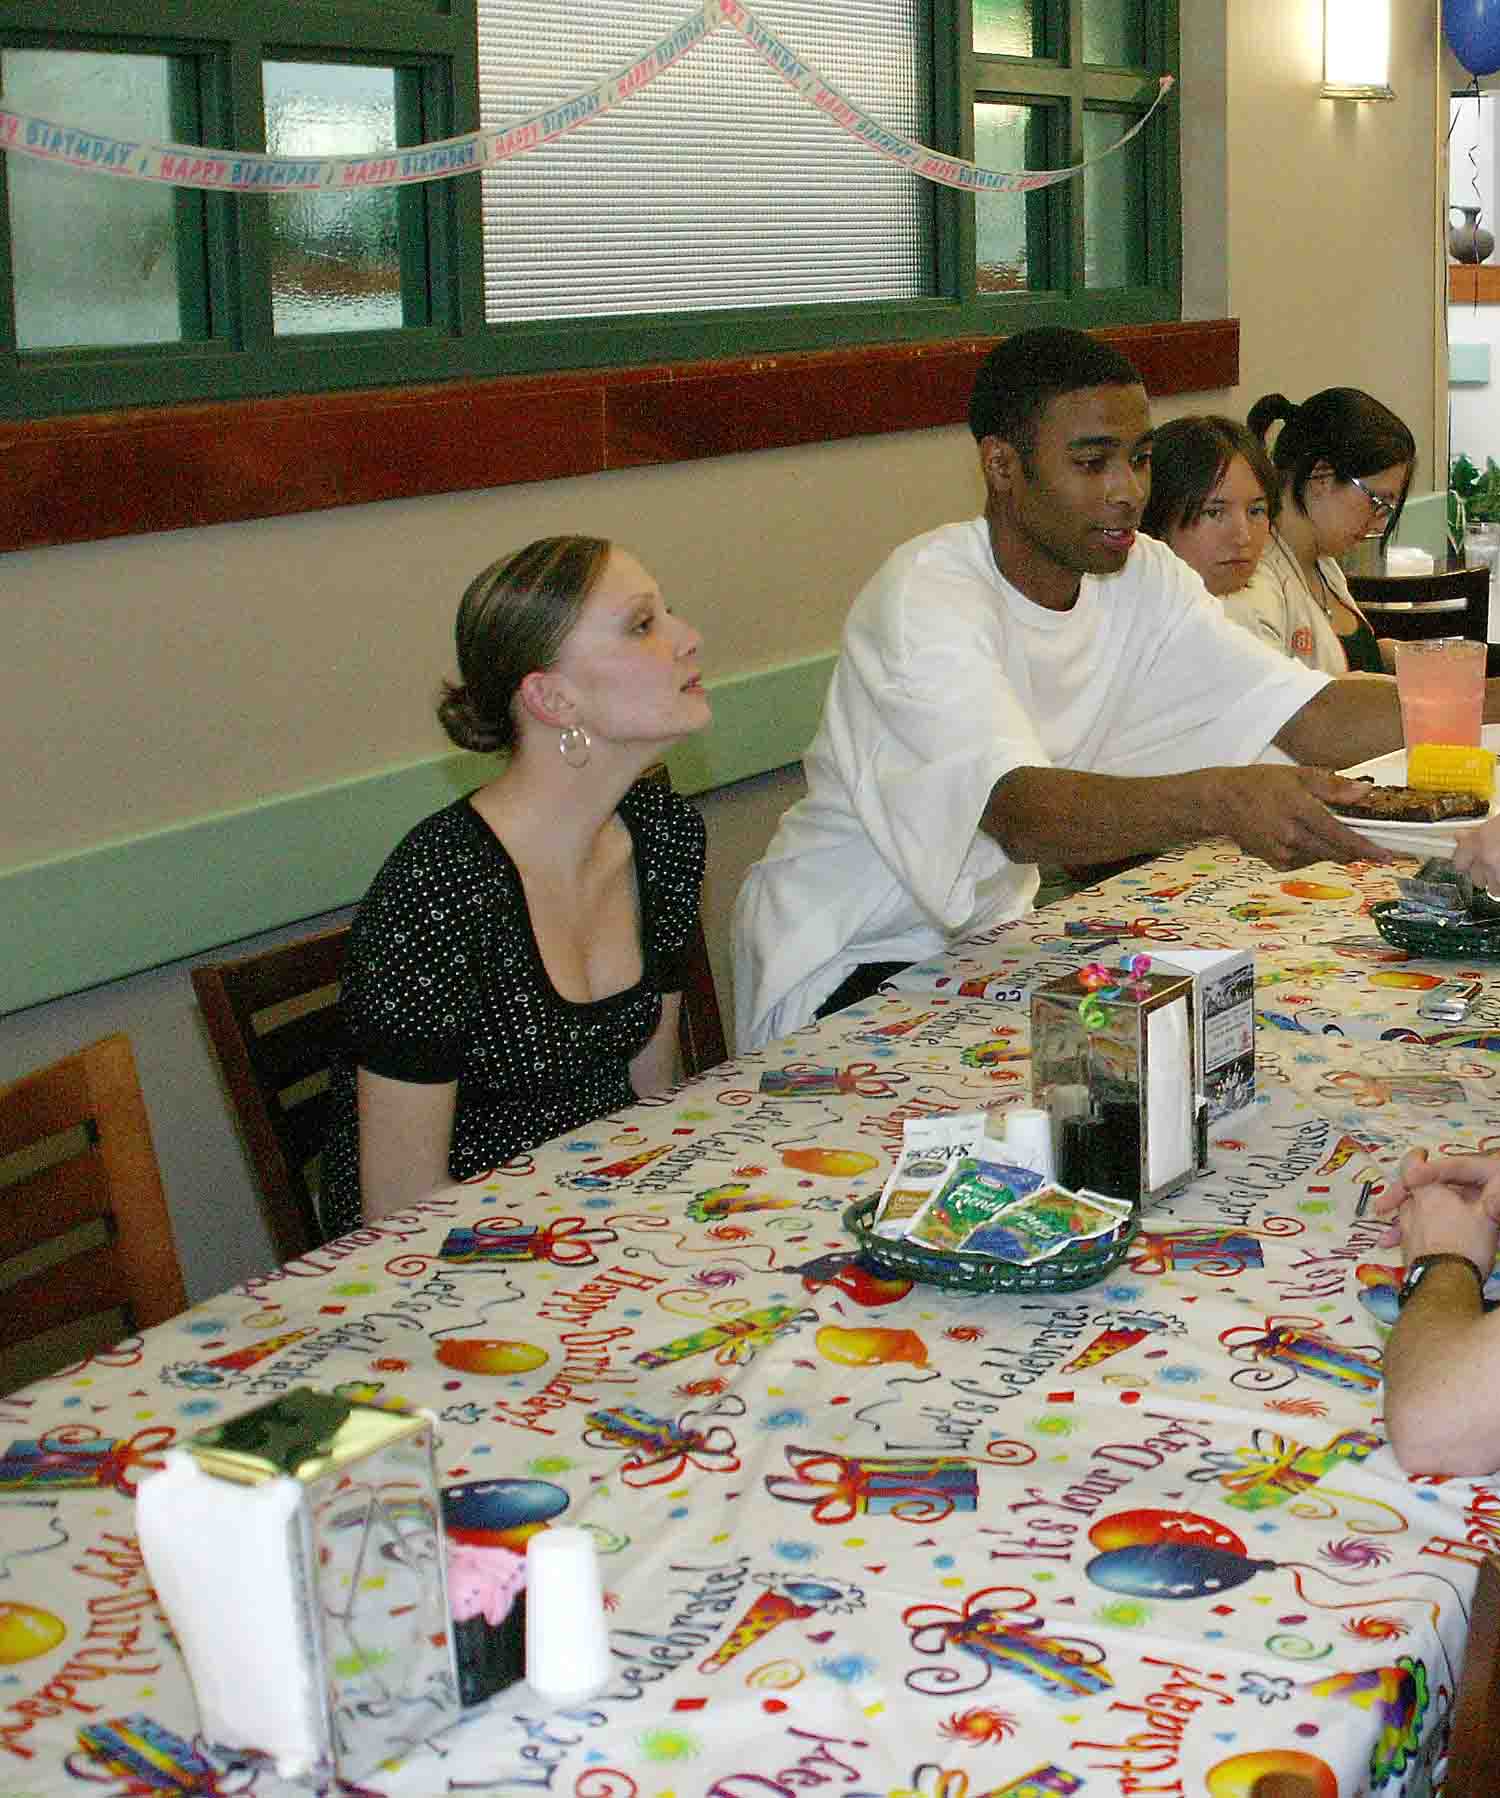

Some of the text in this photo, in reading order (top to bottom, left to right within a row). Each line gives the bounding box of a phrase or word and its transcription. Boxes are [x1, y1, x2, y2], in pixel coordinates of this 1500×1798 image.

[160, 154, 229, 183] HAPPY
[535, 1264, 670, 1329] Happy
[492, 1326, 640, 1436] Birthday!
[884, 1304, 1090, 1453] Let's Celebrate!
[977, 1410, 1214, 1562] It's Your Day!
